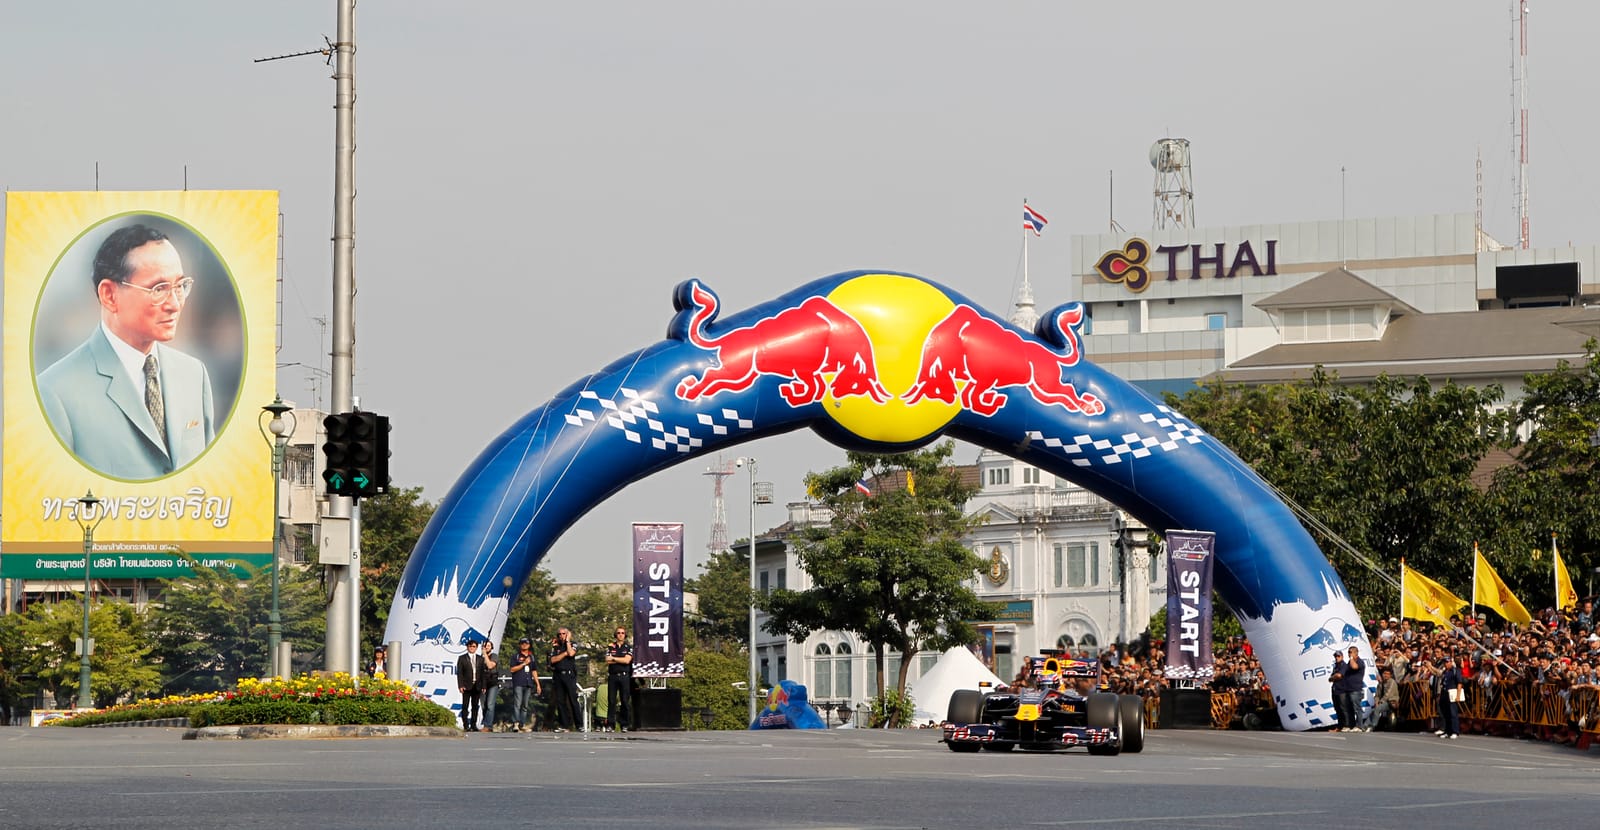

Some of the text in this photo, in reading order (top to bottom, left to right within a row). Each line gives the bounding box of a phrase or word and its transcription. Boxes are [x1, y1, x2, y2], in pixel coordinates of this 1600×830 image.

[1155, 240, 1278, 282] THAI
[42, 486, 232, 528] ทรงพระเจริญ
[352, 551, 358, 559] 5
[648, 562, 671, 653] START
[1179, 570, 1200, 658] START
